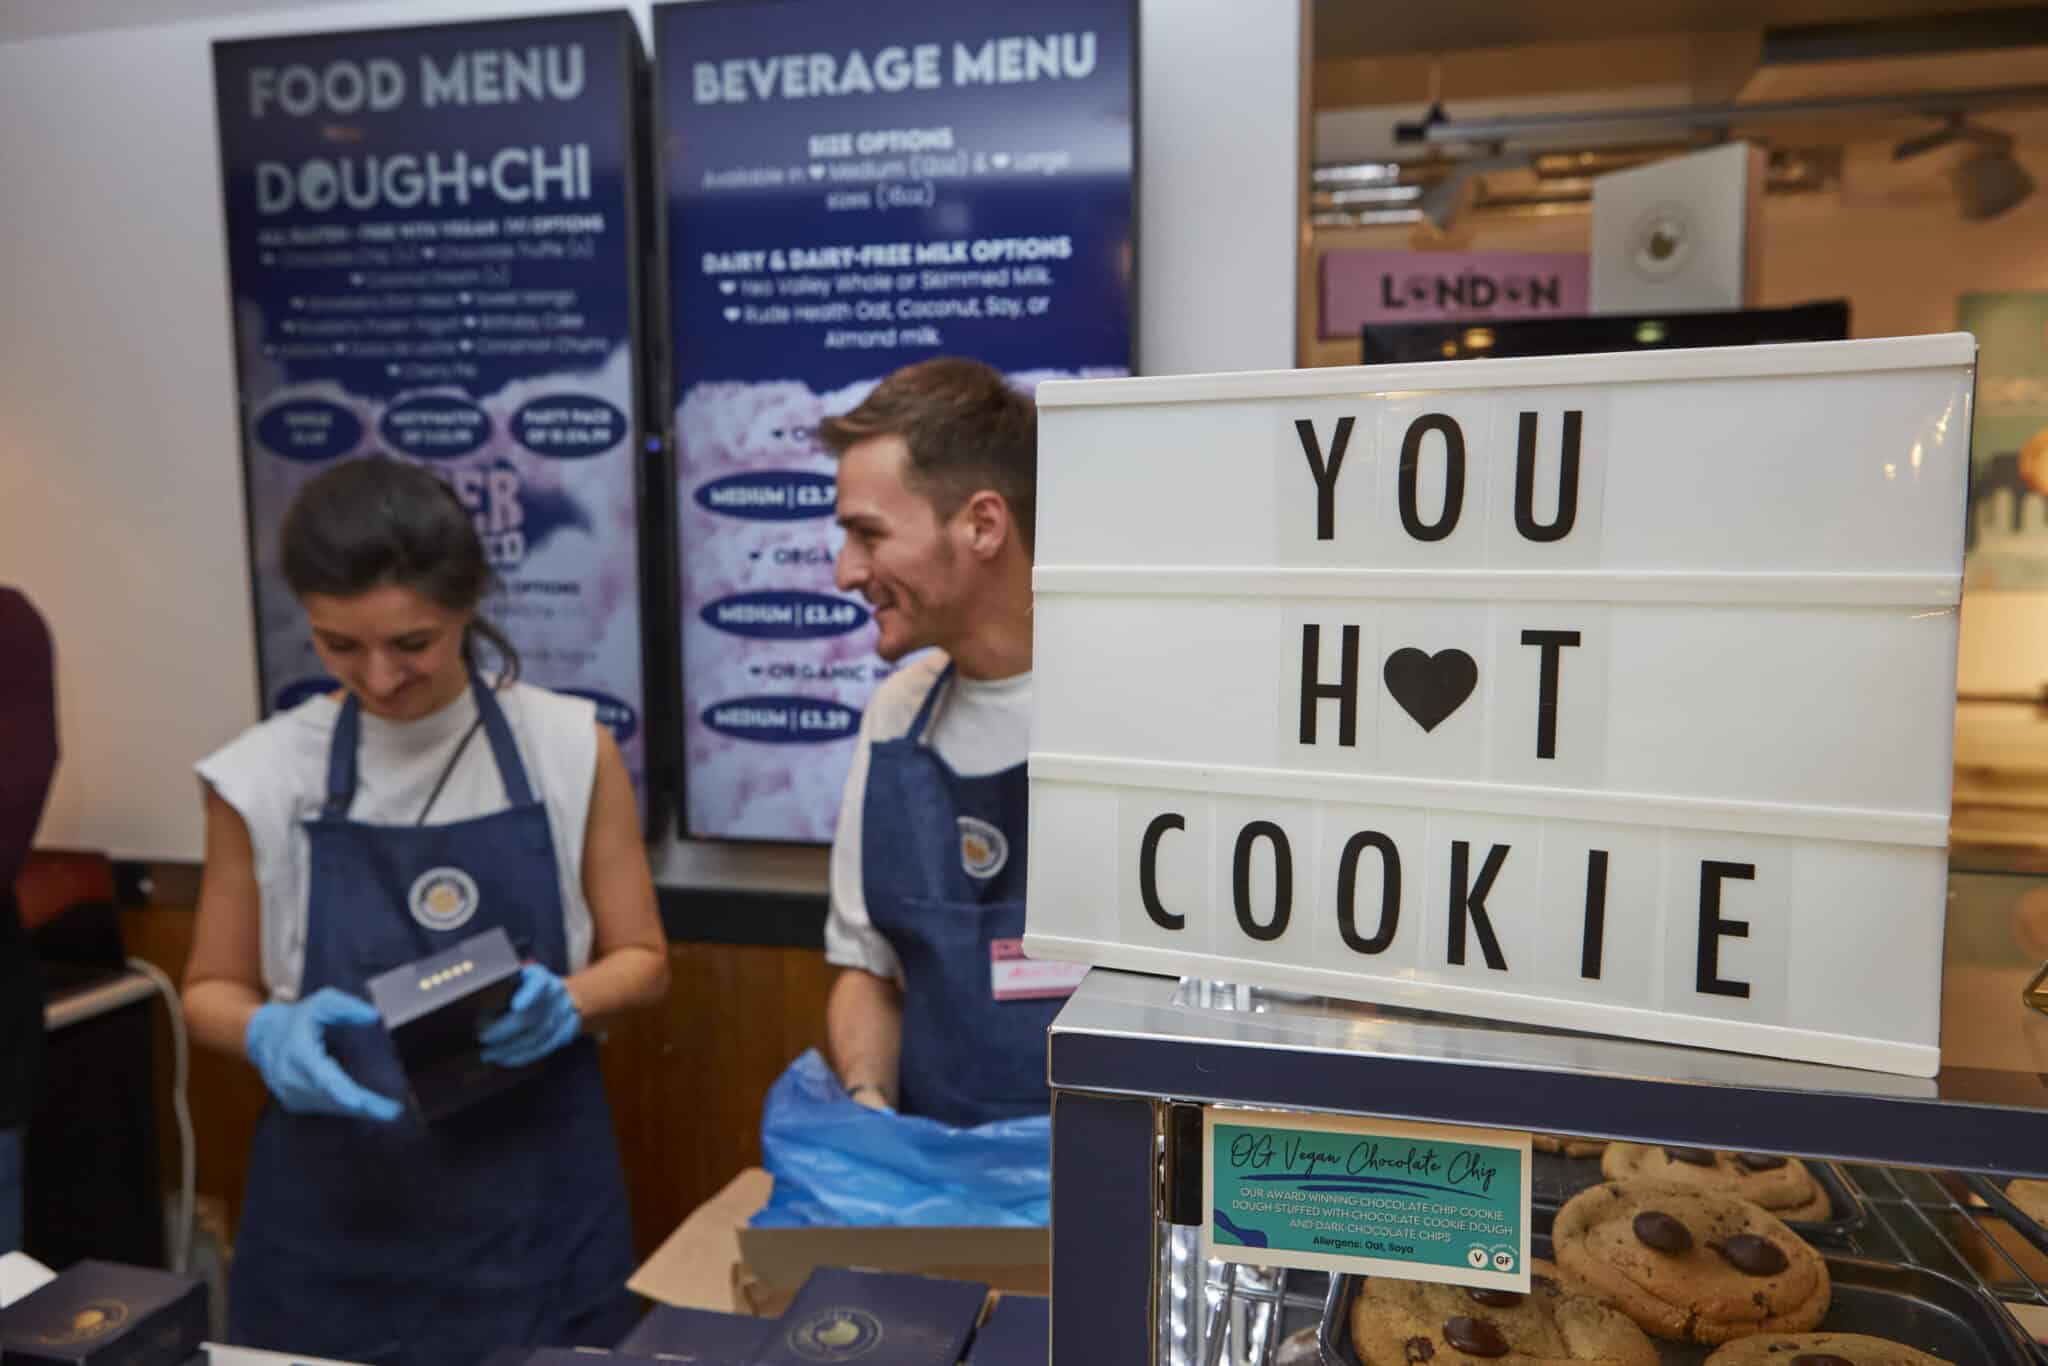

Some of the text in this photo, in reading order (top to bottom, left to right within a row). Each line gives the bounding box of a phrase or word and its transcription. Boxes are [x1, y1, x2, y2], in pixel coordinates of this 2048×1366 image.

[250, 43, 586, 118] FOOD MENU
[693, 31, 1097, 104] BEVERAGE MENU
[856, 126, 953, 155] OPTIONS
[702, 235, 1074, 275] DAIRY & DAIRY-FREE MILK OPTIONS
[856, 300, 895, 321] Oat,
[897, 297, 984, 319] Coconut,
[1027, 294, 1050, 315] or
[825, 327, 897, 349] Almond
[1294, 410, 1583, 542] YOU
[709, 485, 787, 507] MEDIUM
[717, 603, 794, 625] MEDIUM
[767, 663, 868, 683] ORGANIC
[714, 707, 789, 728] MEDIUM
[1138, 812, 1757, 1000] COOKIE
[1231, 1133, 1497, 1193] OG Vegan Chocolate Chip
[1232, 1199, 1513, 1236] DOUGH STUFFED WITH CHOCOLATE COOKIE DOUGH
[1240, 1186, 1505, 1221] OUR AWARD WINNING CHOCOLATE CHIP COOKIE
[1289, 1219, 1452, 1243] AND DARK CHOCOLATE CHIPS
[1312, 1236, 1414, 1254] Allergens: Oat, Soya
[1473, 1252, 1512, 1266] V GF
